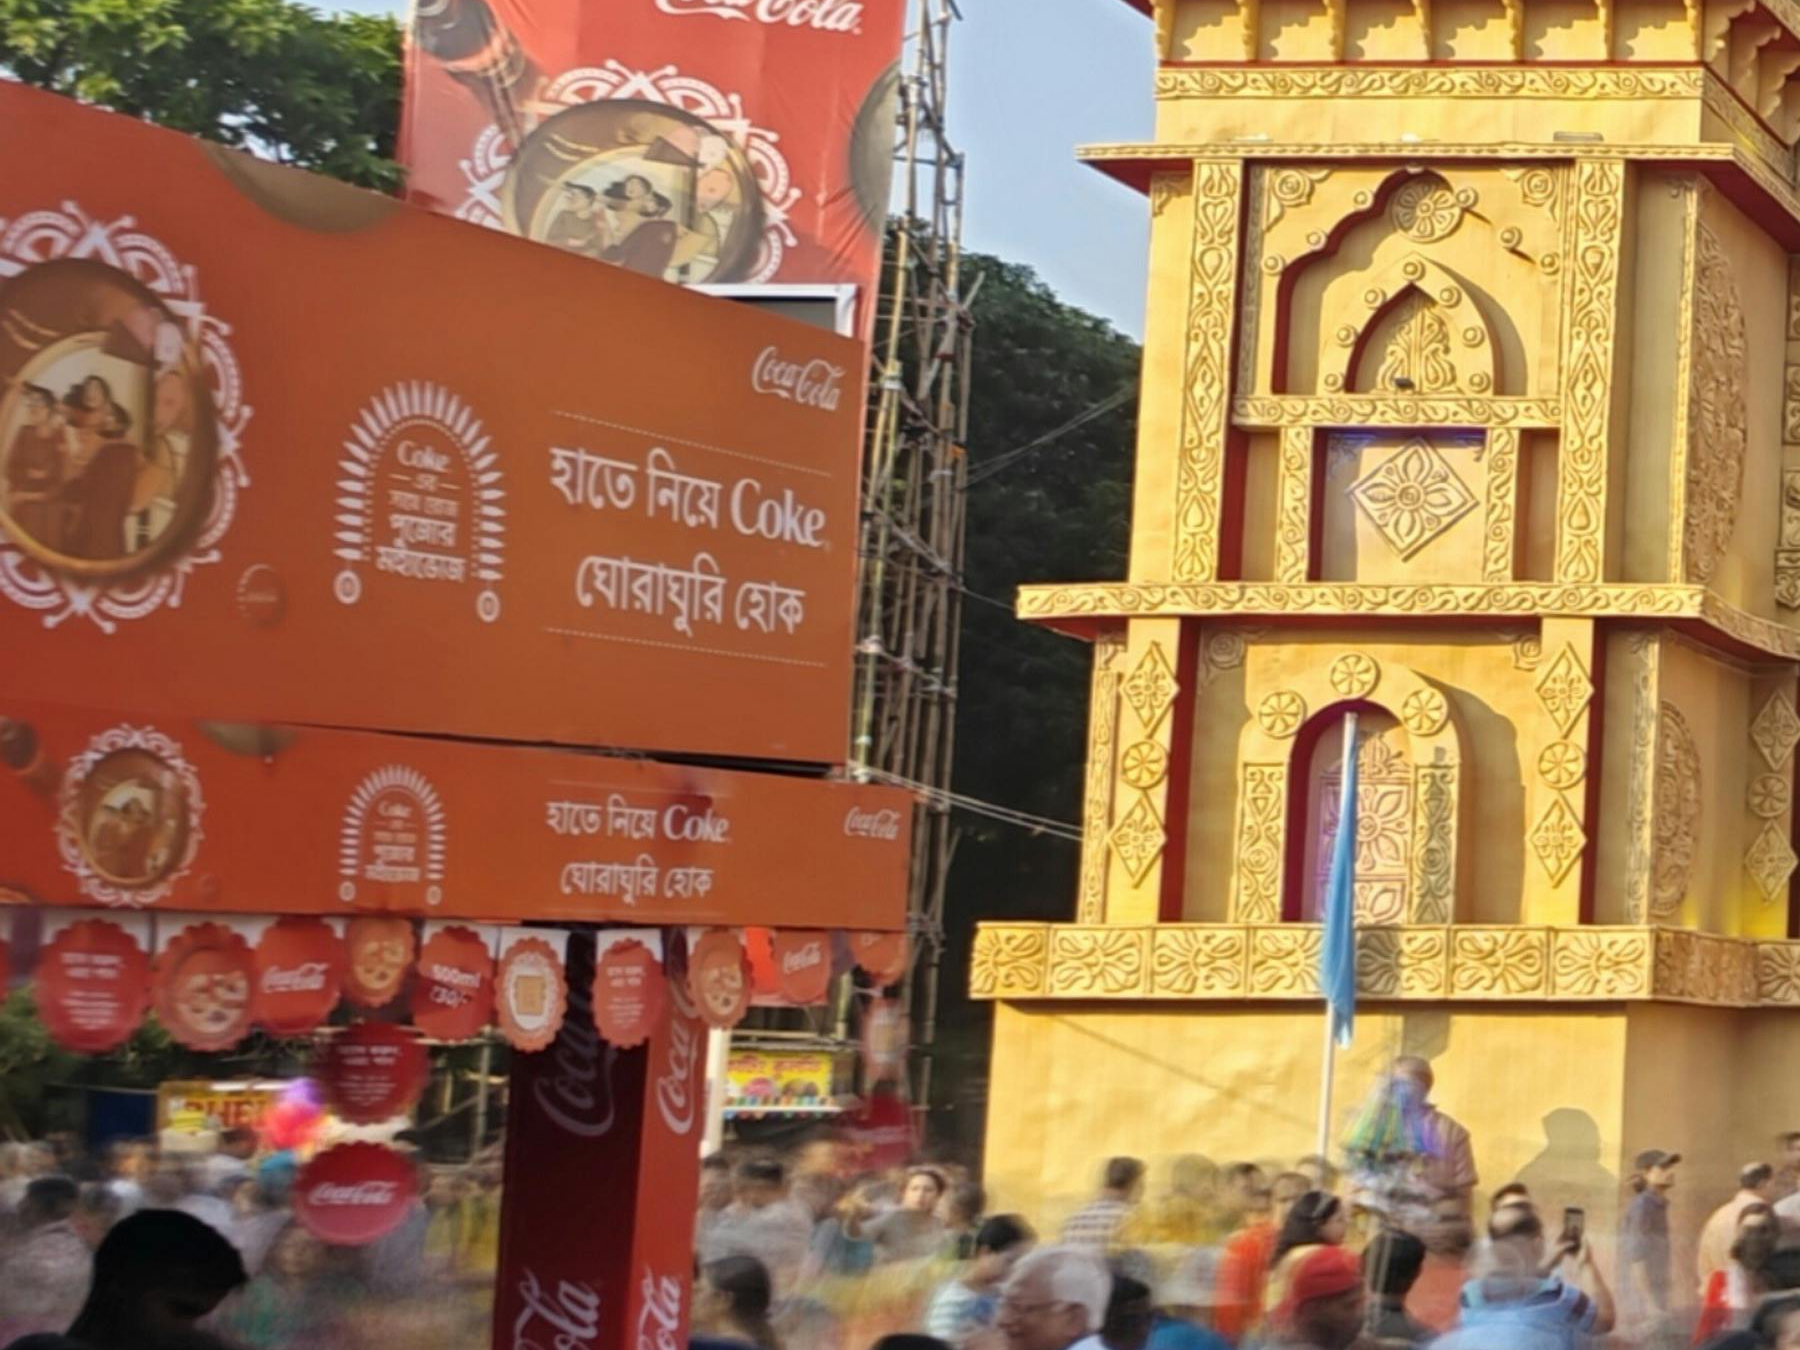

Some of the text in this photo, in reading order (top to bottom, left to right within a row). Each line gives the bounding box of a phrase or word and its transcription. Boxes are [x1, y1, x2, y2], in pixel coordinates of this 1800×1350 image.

[752, 346, 846, 411] Coca-Cola
[397, 440, 450, 473] Coke
[549, 447, 829, 548] হাতে নিয়ে Coke
[576, 552, 806, 637] ঘোরাঘুরি হোক
[545, 793, 731, 843] হাতে নিয়ে Coke
[844, 805, 902, 840] Coca-Cola
[560, 853, 716, 906] ঘোরাঘুরি হোক
